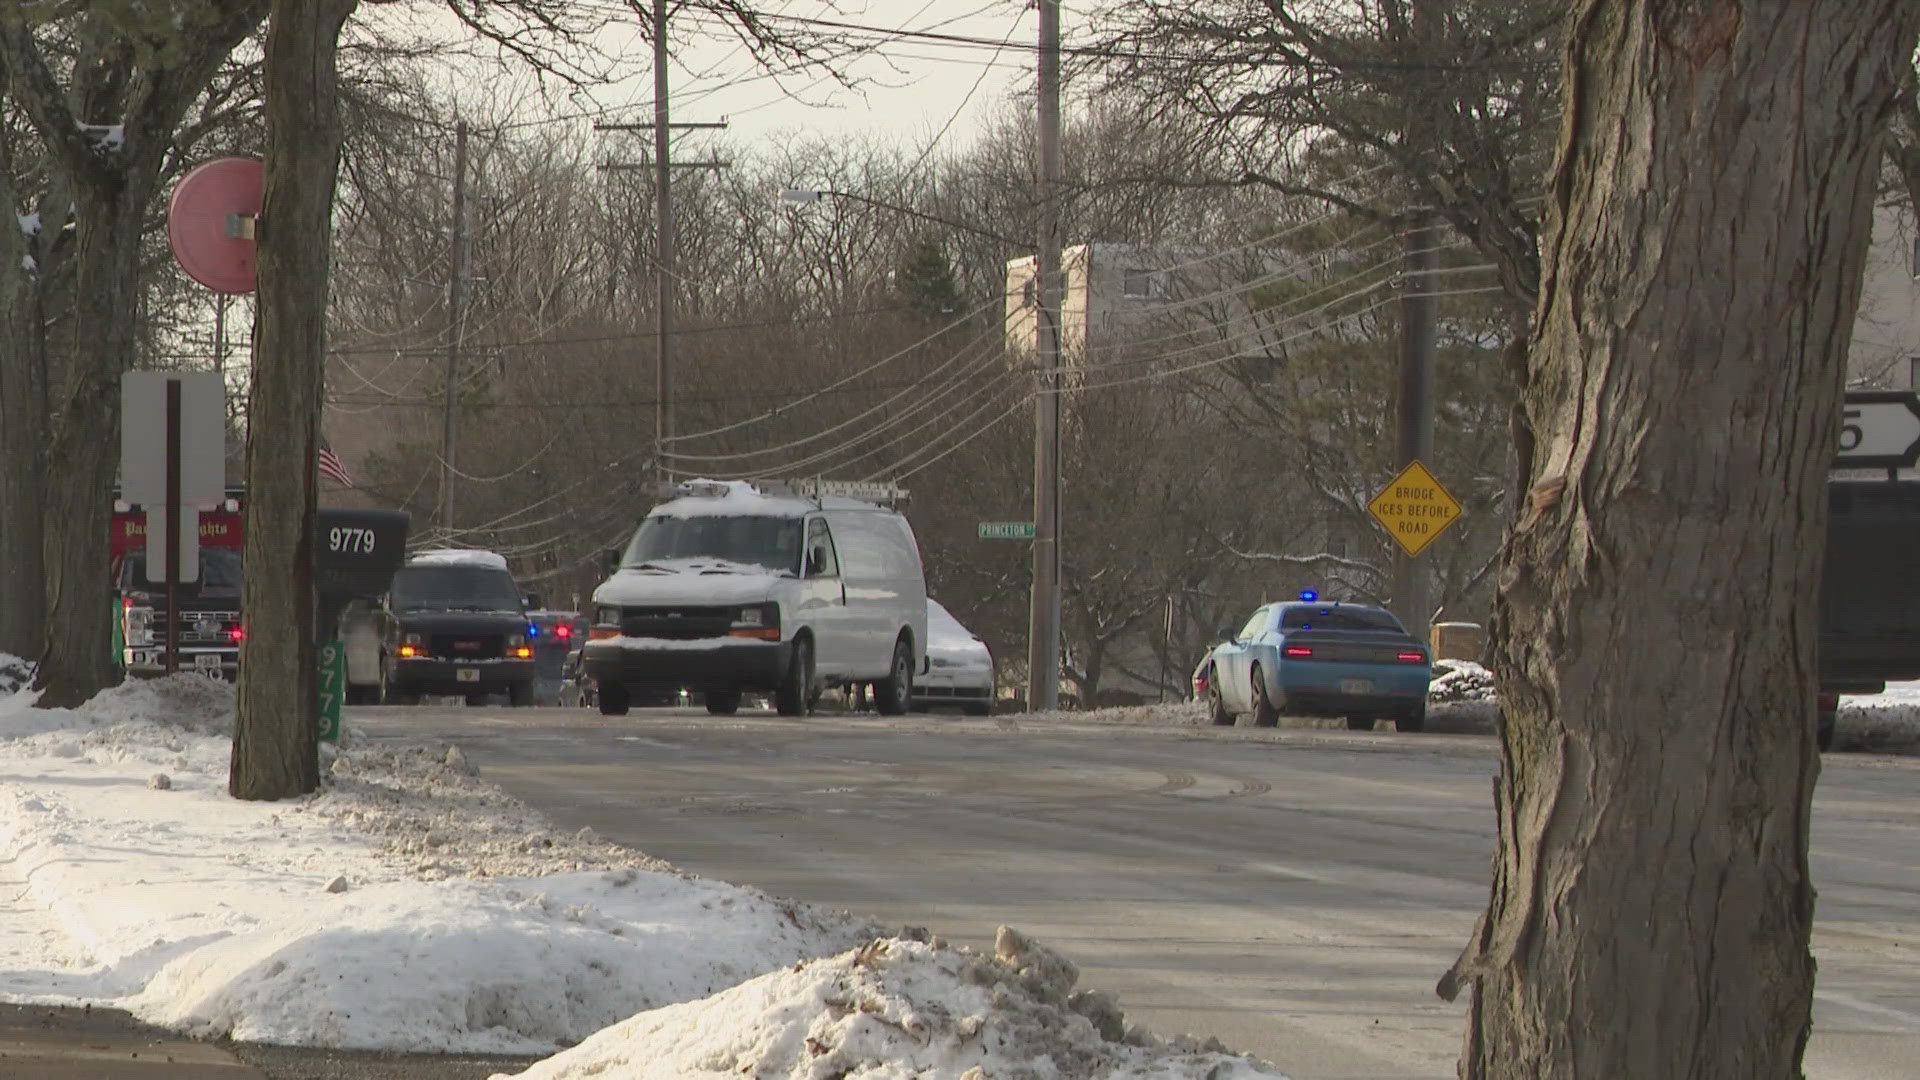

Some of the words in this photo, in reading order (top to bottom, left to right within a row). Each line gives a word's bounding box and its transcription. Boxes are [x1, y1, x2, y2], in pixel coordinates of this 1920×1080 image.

[1396, 487, 1434, 500] BRIDGE
[1379, 503, 1402, 515] ICES
[1408, 505, 1450, 518] BEFORE
[981, 523, 1025, 537] PRINCETON
[1398, 521, 1429, 534] ROAD
[329, 527, 376, 553] 9779
[319, 646, 337, 736] 9779
